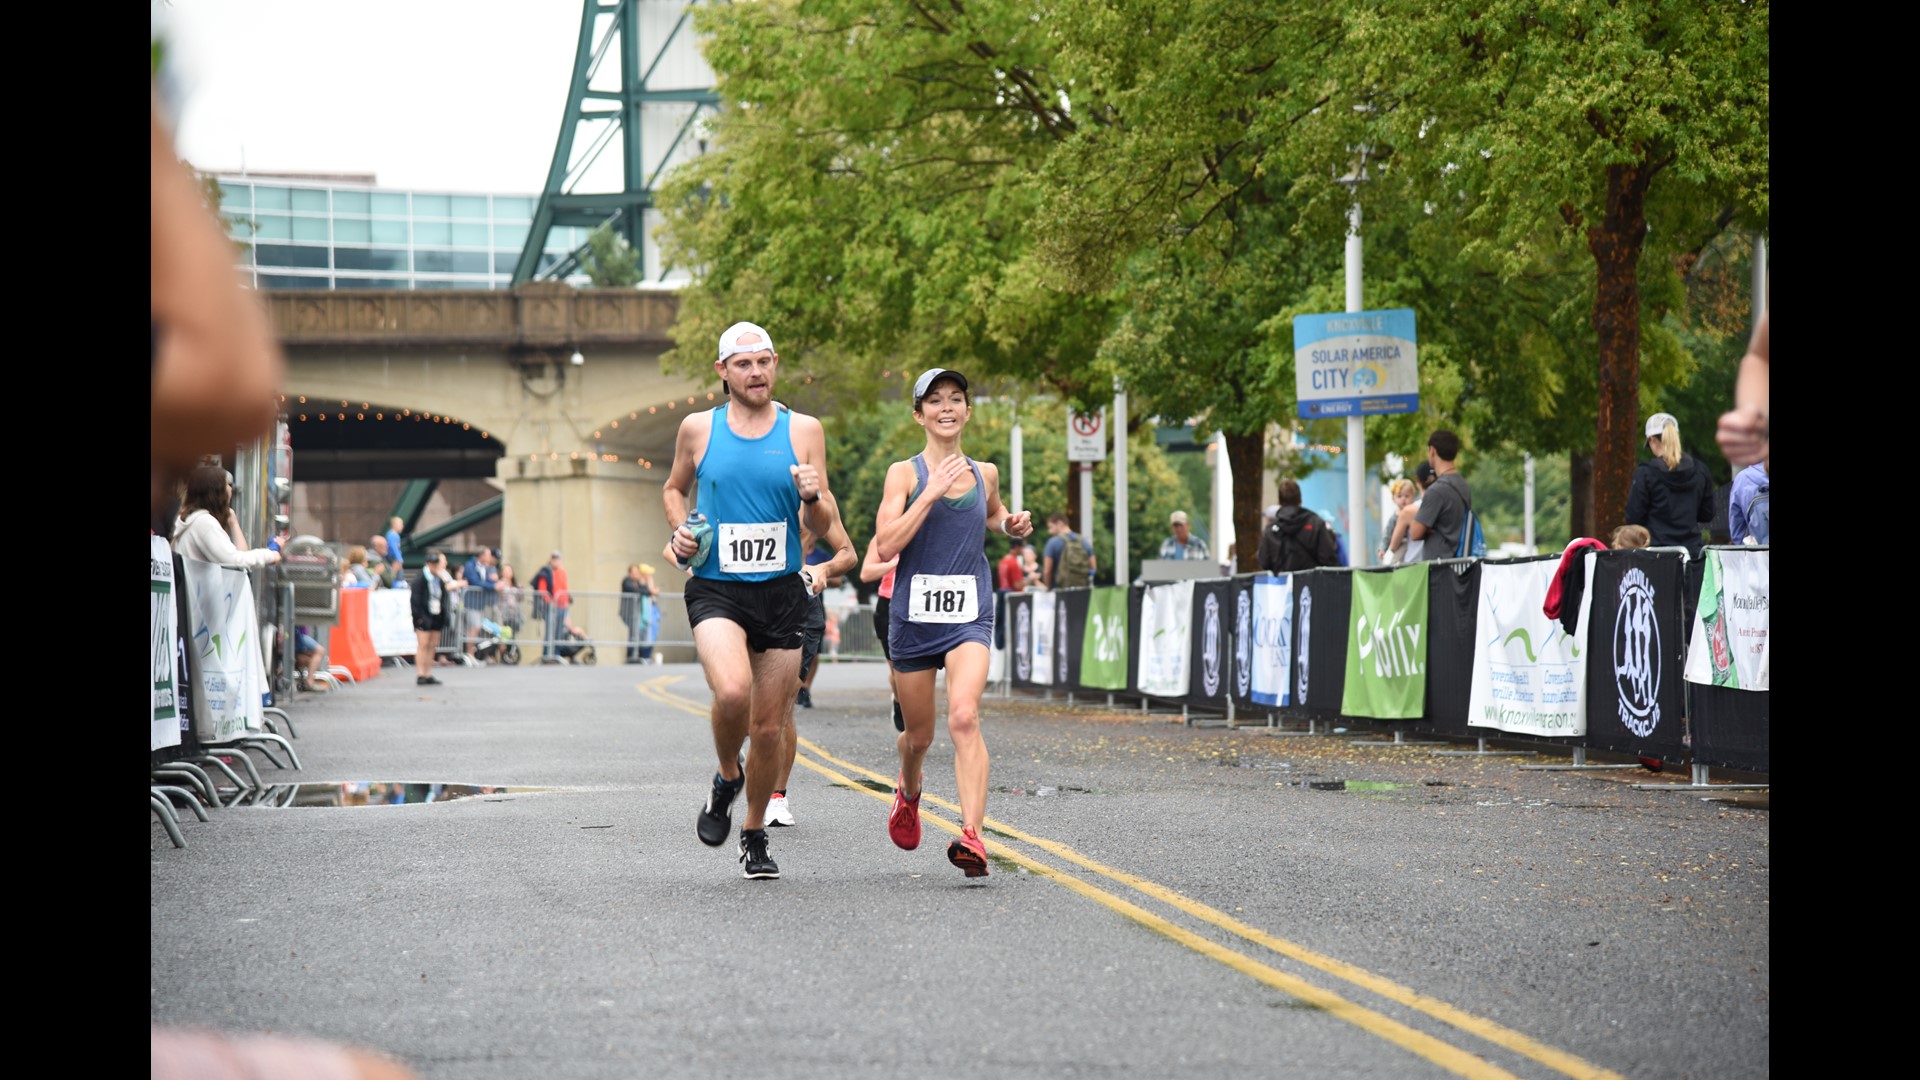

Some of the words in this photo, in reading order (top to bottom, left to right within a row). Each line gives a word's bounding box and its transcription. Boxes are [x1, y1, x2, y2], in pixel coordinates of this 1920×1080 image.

[1327, 316, 1384, 333] KNOXVILLE
[1312, 349, 1349, 364] SOLAR
[1352, 346, 1402, 361] AMERICA
[1312, 368, 1349, 390] CITY
[1321, 403, 1353, 414] ENERGY
[728, 537, 777, 563] 1072
[1619, 567, 1656, 605] KNOXVILLE
[922, 589, 966, 613] 1187
